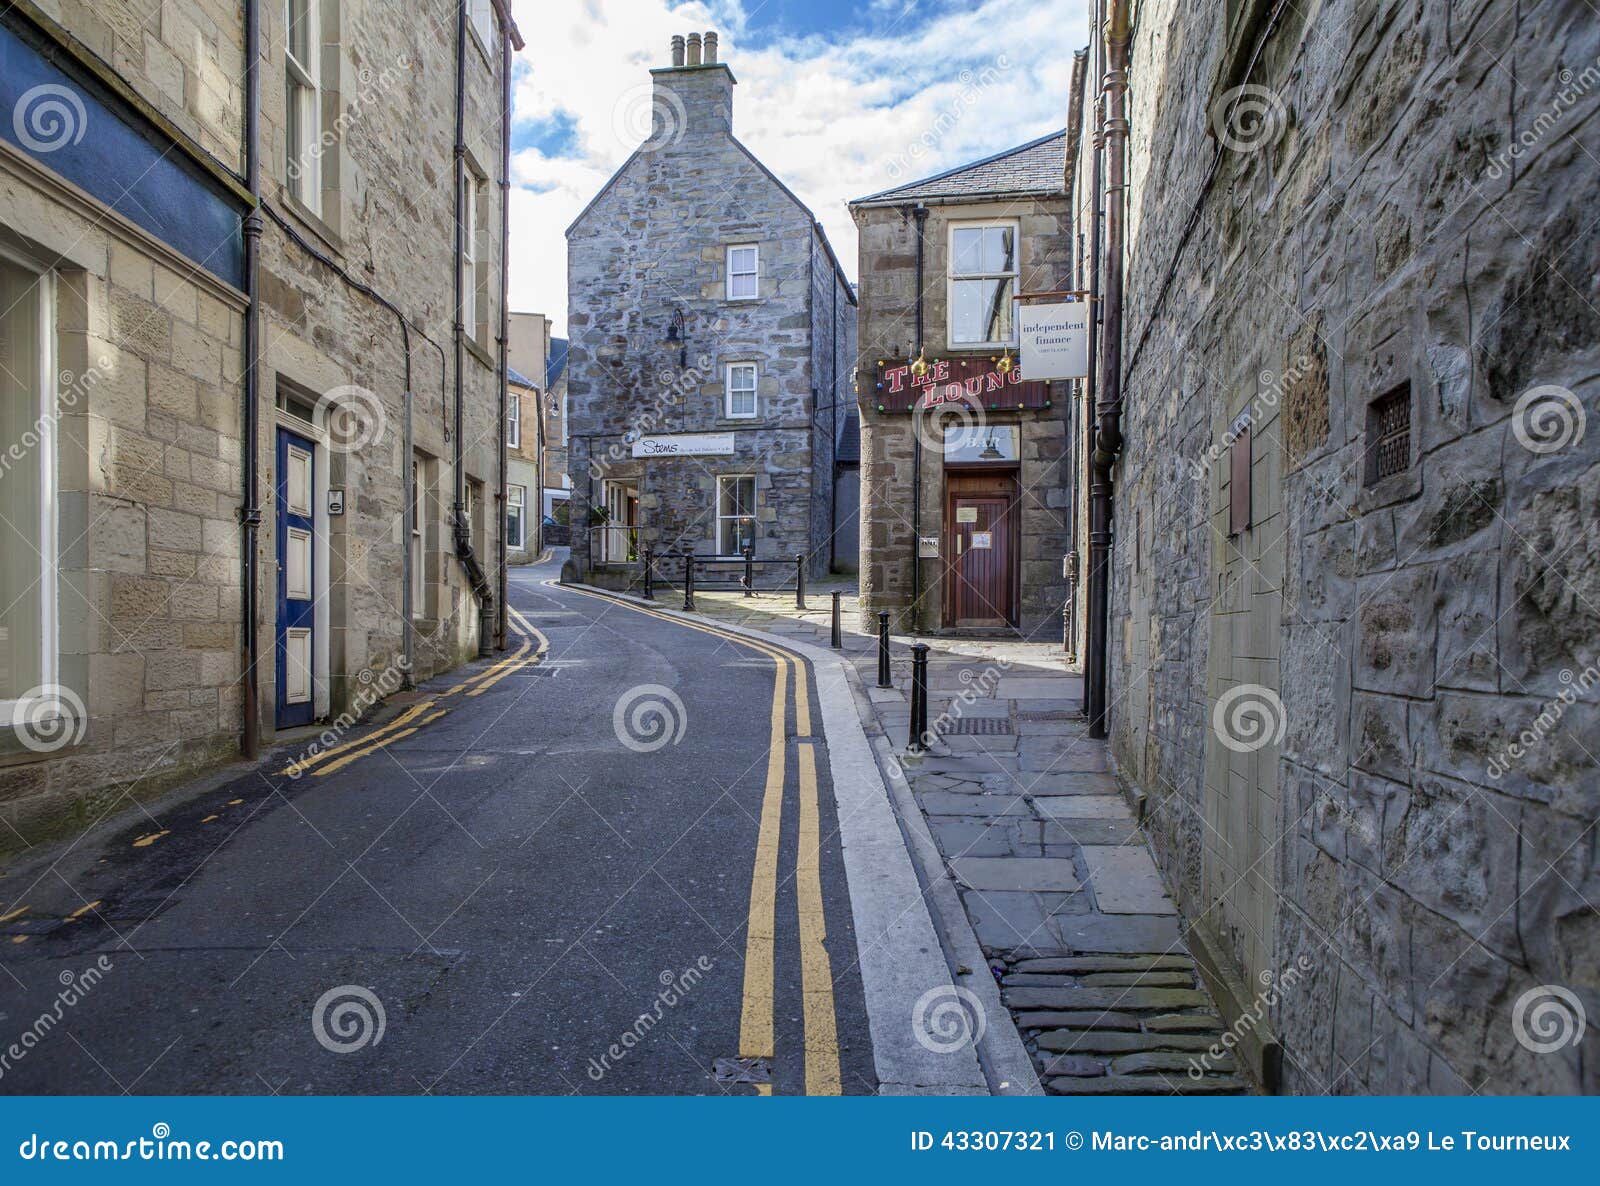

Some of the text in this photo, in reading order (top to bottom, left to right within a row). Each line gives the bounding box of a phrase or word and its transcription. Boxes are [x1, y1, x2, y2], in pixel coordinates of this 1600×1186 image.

[1023, 321, 1084, 334] independent
[1035, 336, 1072, 345] finance
[884, 360, 949, 394] THE
[642, 440, 679, 454] Stems
